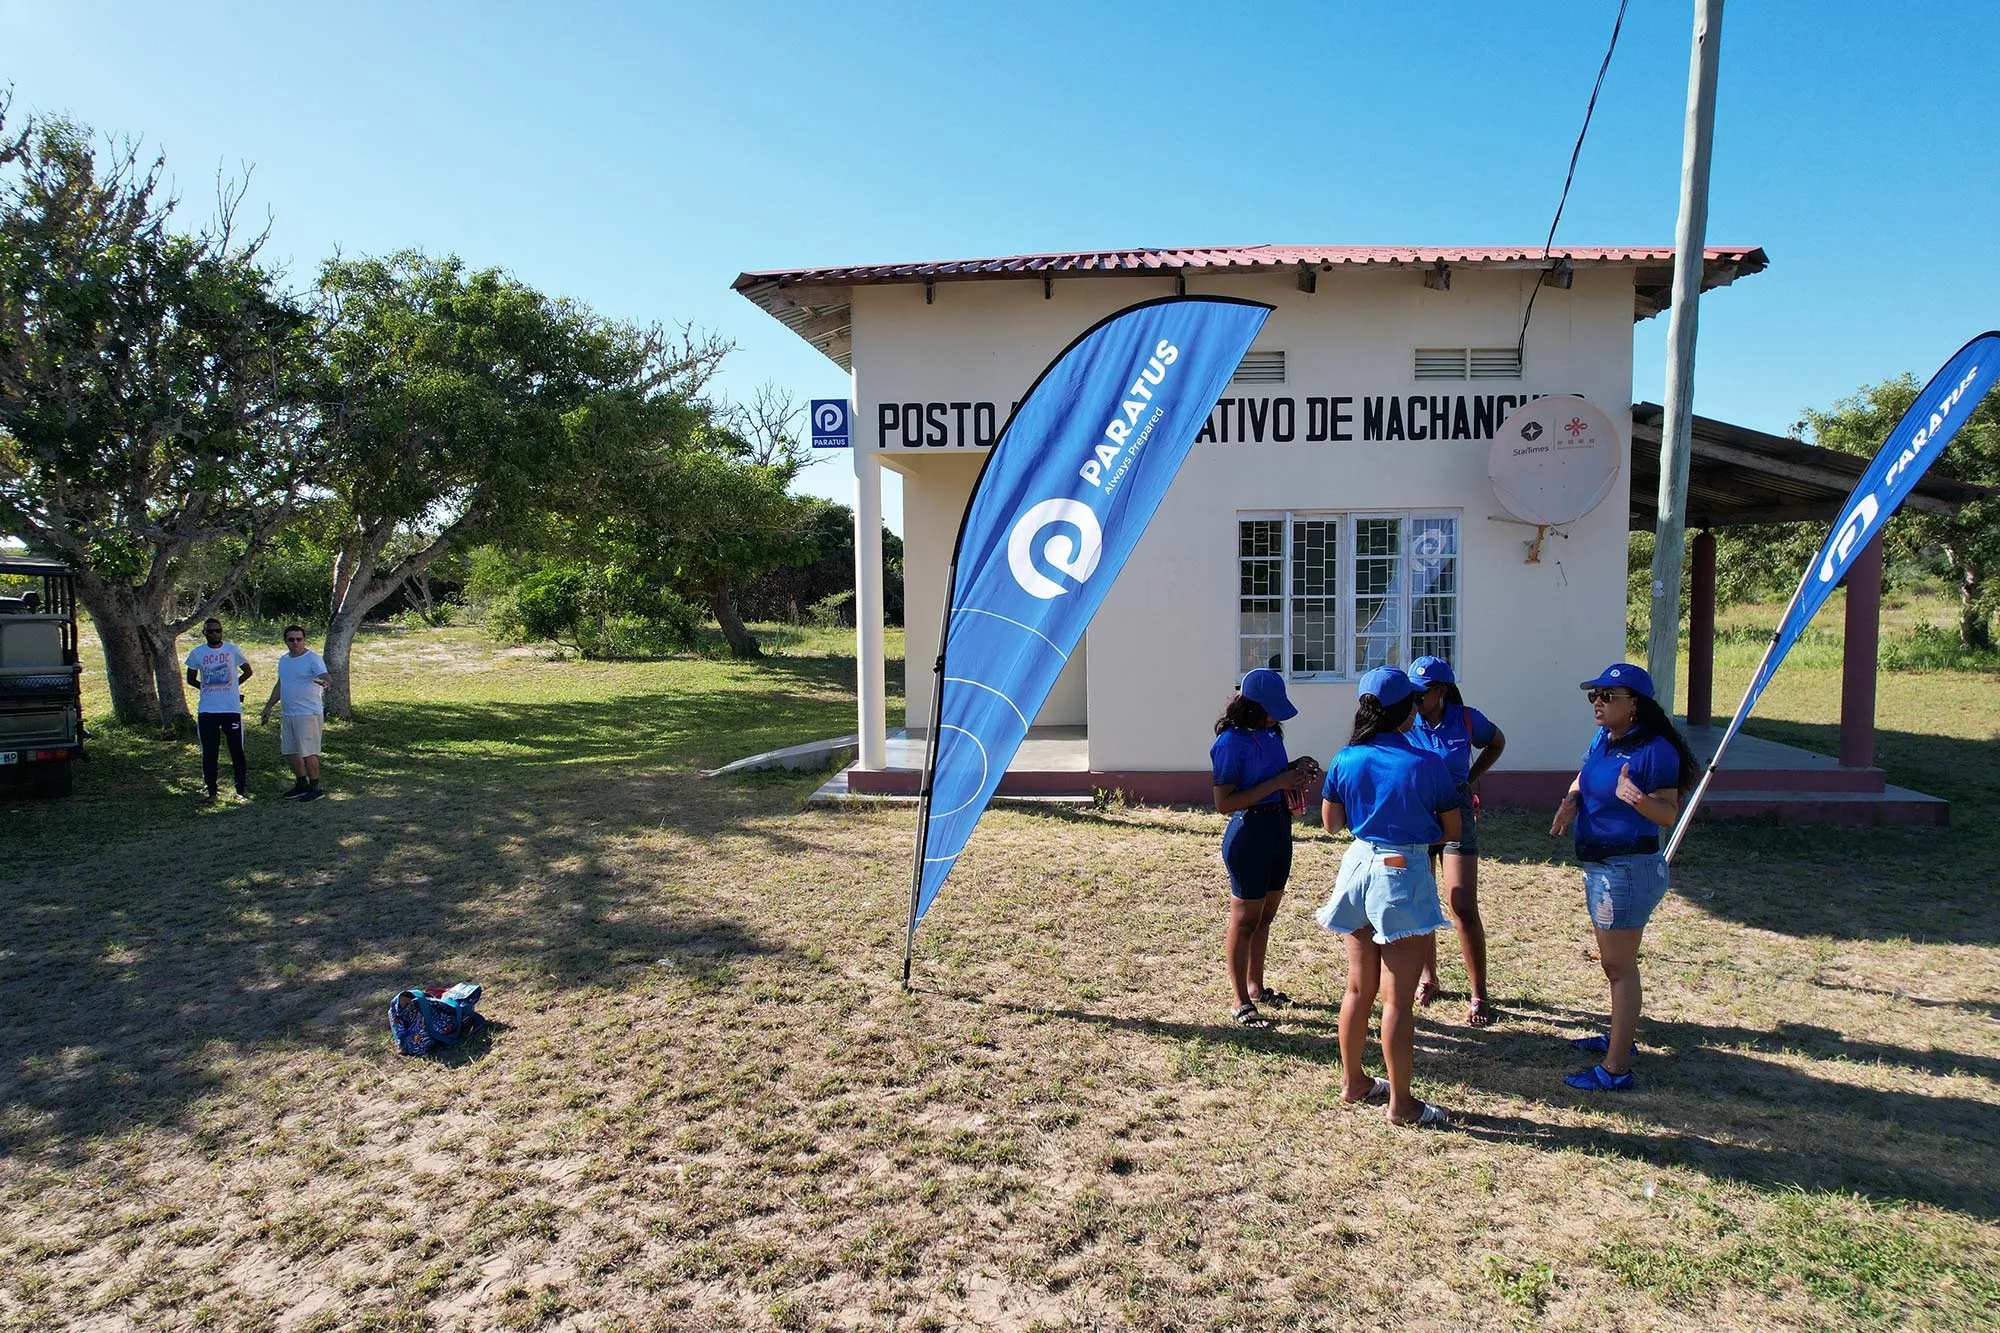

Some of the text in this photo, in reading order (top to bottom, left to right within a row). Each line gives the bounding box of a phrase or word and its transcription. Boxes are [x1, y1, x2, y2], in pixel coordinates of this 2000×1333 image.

[878, 402, 996, 448] POSTO
[1194, 397, 1295, 444] ATIVO
[1306, 397, 1353, 442] DE
[1079, 339, 1179, 488] PARATUS
[814, 438, 846, 446] PARATUS
[1104, 406, 1164, 496] Always Prepared
[1513, 445, 1550, 457] StarTimes
